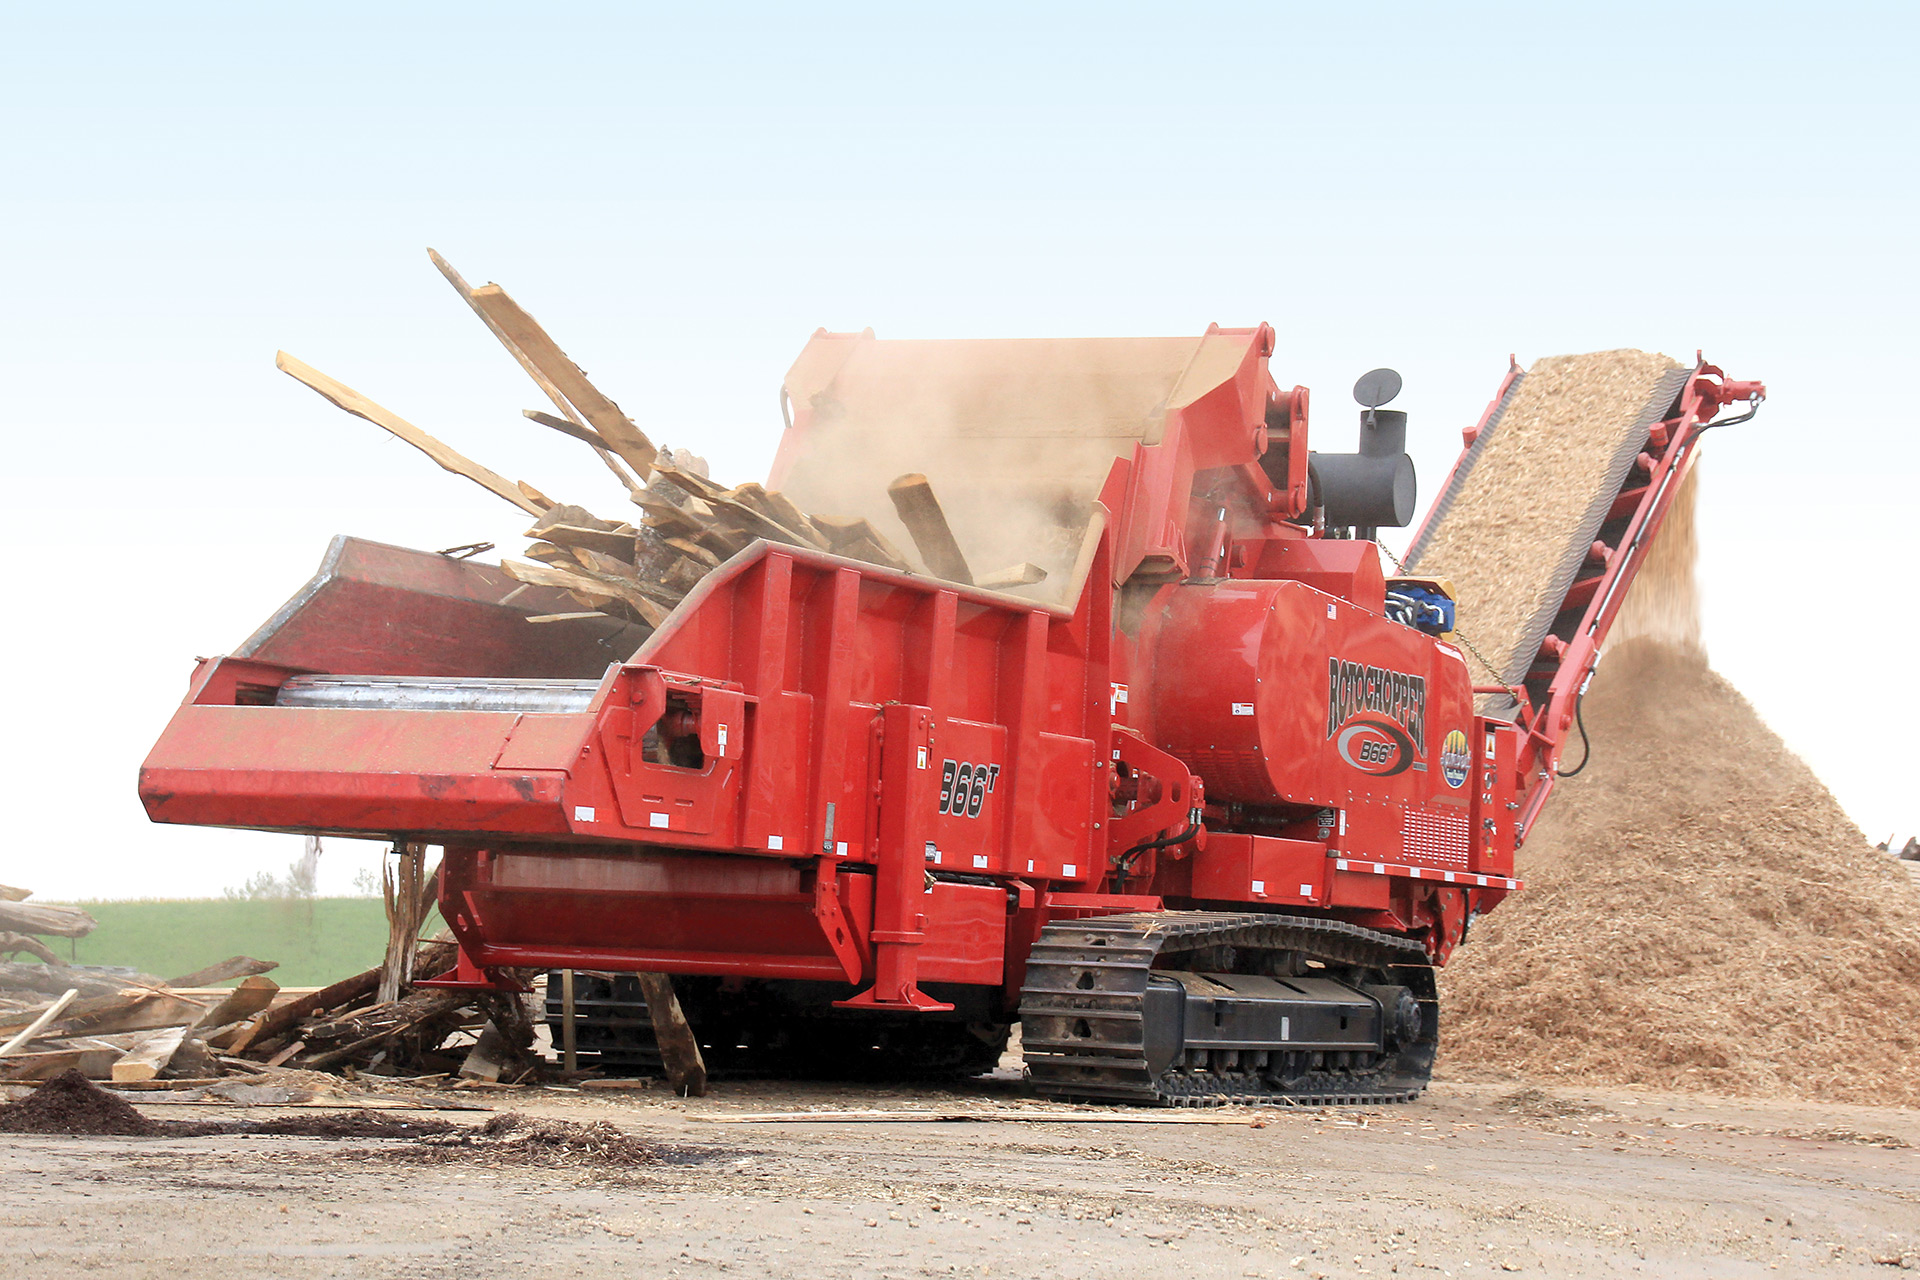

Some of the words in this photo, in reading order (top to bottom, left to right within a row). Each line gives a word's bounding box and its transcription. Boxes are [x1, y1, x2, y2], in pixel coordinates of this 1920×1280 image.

[1326, 656, 1426, 759] ROTOCHOPPER
[1359, 739, 1397, 765] B66T
[938, 758, 1001, 819] B66T
